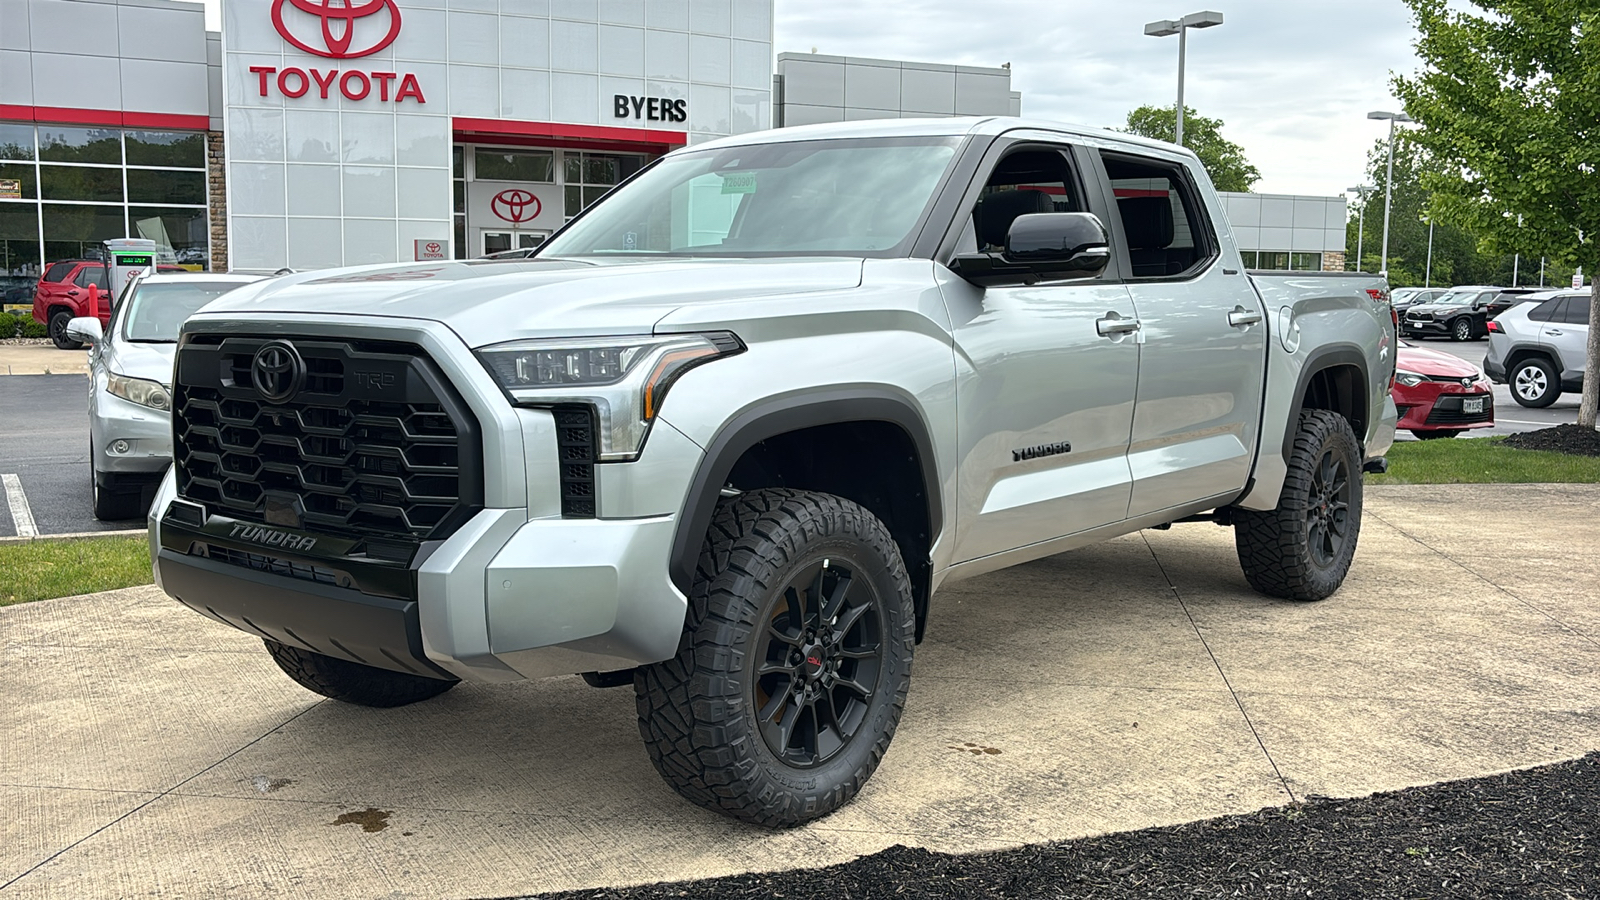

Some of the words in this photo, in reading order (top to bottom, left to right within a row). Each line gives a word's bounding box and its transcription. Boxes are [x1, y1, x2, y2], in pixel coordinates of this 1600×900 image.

[249, 66, 426, 104] TOYOTA
[614, 94, 687, 122] BYERS
[353, 371, 395, 390] TRD
[1011, 441, 1072, 462] TUNDRA
[229, 522, 318, 551] TUNDRA
